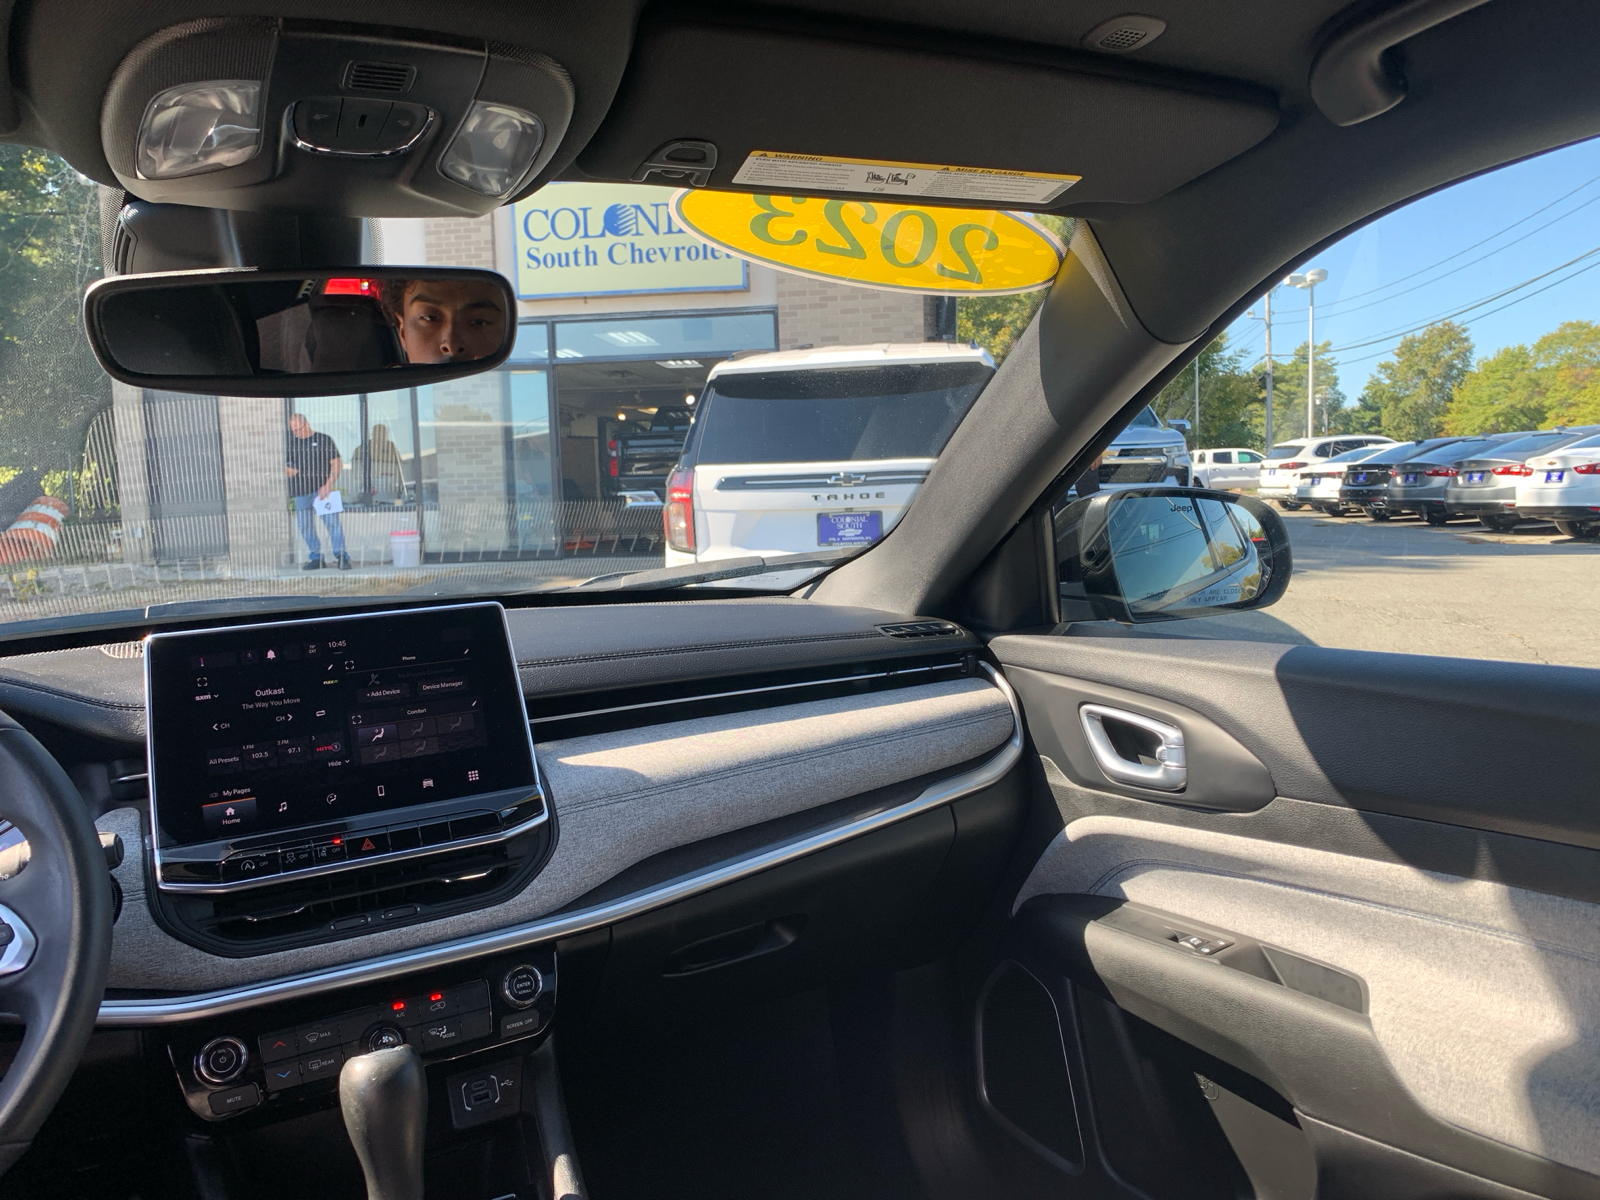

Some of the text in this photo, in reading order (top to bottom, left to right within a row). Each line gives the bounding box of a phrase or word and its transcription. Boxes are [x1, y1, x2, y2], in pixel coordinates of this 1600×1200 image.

[774, 153, 823, 162] WARNING
[523, 203, 688, 242] COLONI
[526, 244, 599, 270] South
[812, 492, 885, 501] TAHOE
[1170, 505, 1193, 514] Jeep
[830, 516, 869, 524] COLONIAL
[836, 522, 863, 530] SOUTH
[328, 640, 347, 648] 10:45
[441, 680, 464, 689] Manager
[255, 687, 285, 697] Outkast
[382, 688, 400, 696] Device
[255, 701, 269, 709] Way
[283, 697, 301, 705] Move
[407, 707, 427, 715] Comfort
[287, 746, 301, 754] 97.1
[251, 751, 269, 759] 103.5
[218, 755, 240, 764] Presets
[233, 787, 251, 796] Pages
[516, 981, 531, 989] ENTER
[506, 1021, 523, 1029] SCREEN
[442, 1031, 456, 1039] MODE
[321, 1058, 335, 1066] REAR
[226, 1095, 242, 1104] MUTE
